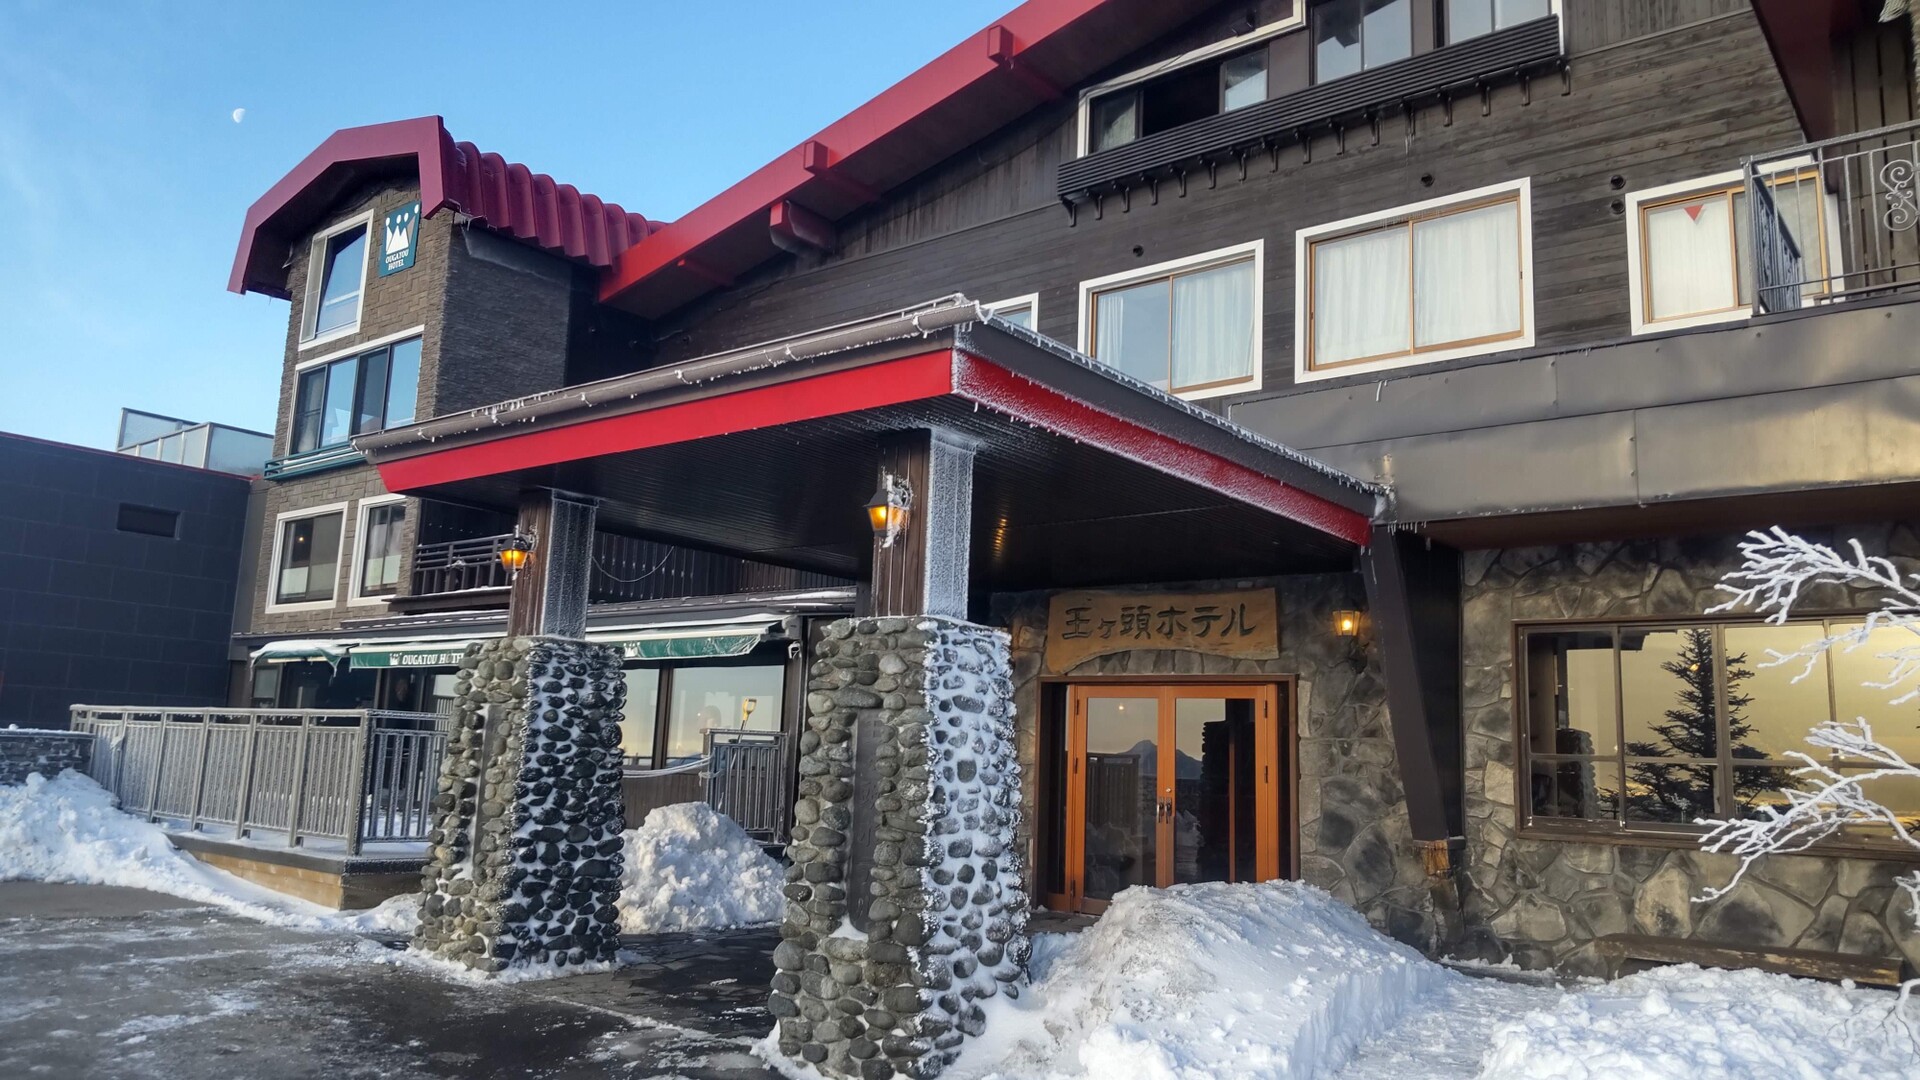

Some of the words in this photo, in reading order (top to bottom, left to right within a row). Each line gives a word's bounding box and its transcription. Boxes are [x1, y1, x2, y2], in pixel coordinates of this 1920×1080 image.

[386, 249, 409, 263] OUGATOU
[388, 259, 404, 270] HOTEL
[1062, 603, 1256, 640] 王ヶ頭ホテル
[402, 653, 438, 665] OUGATOU
